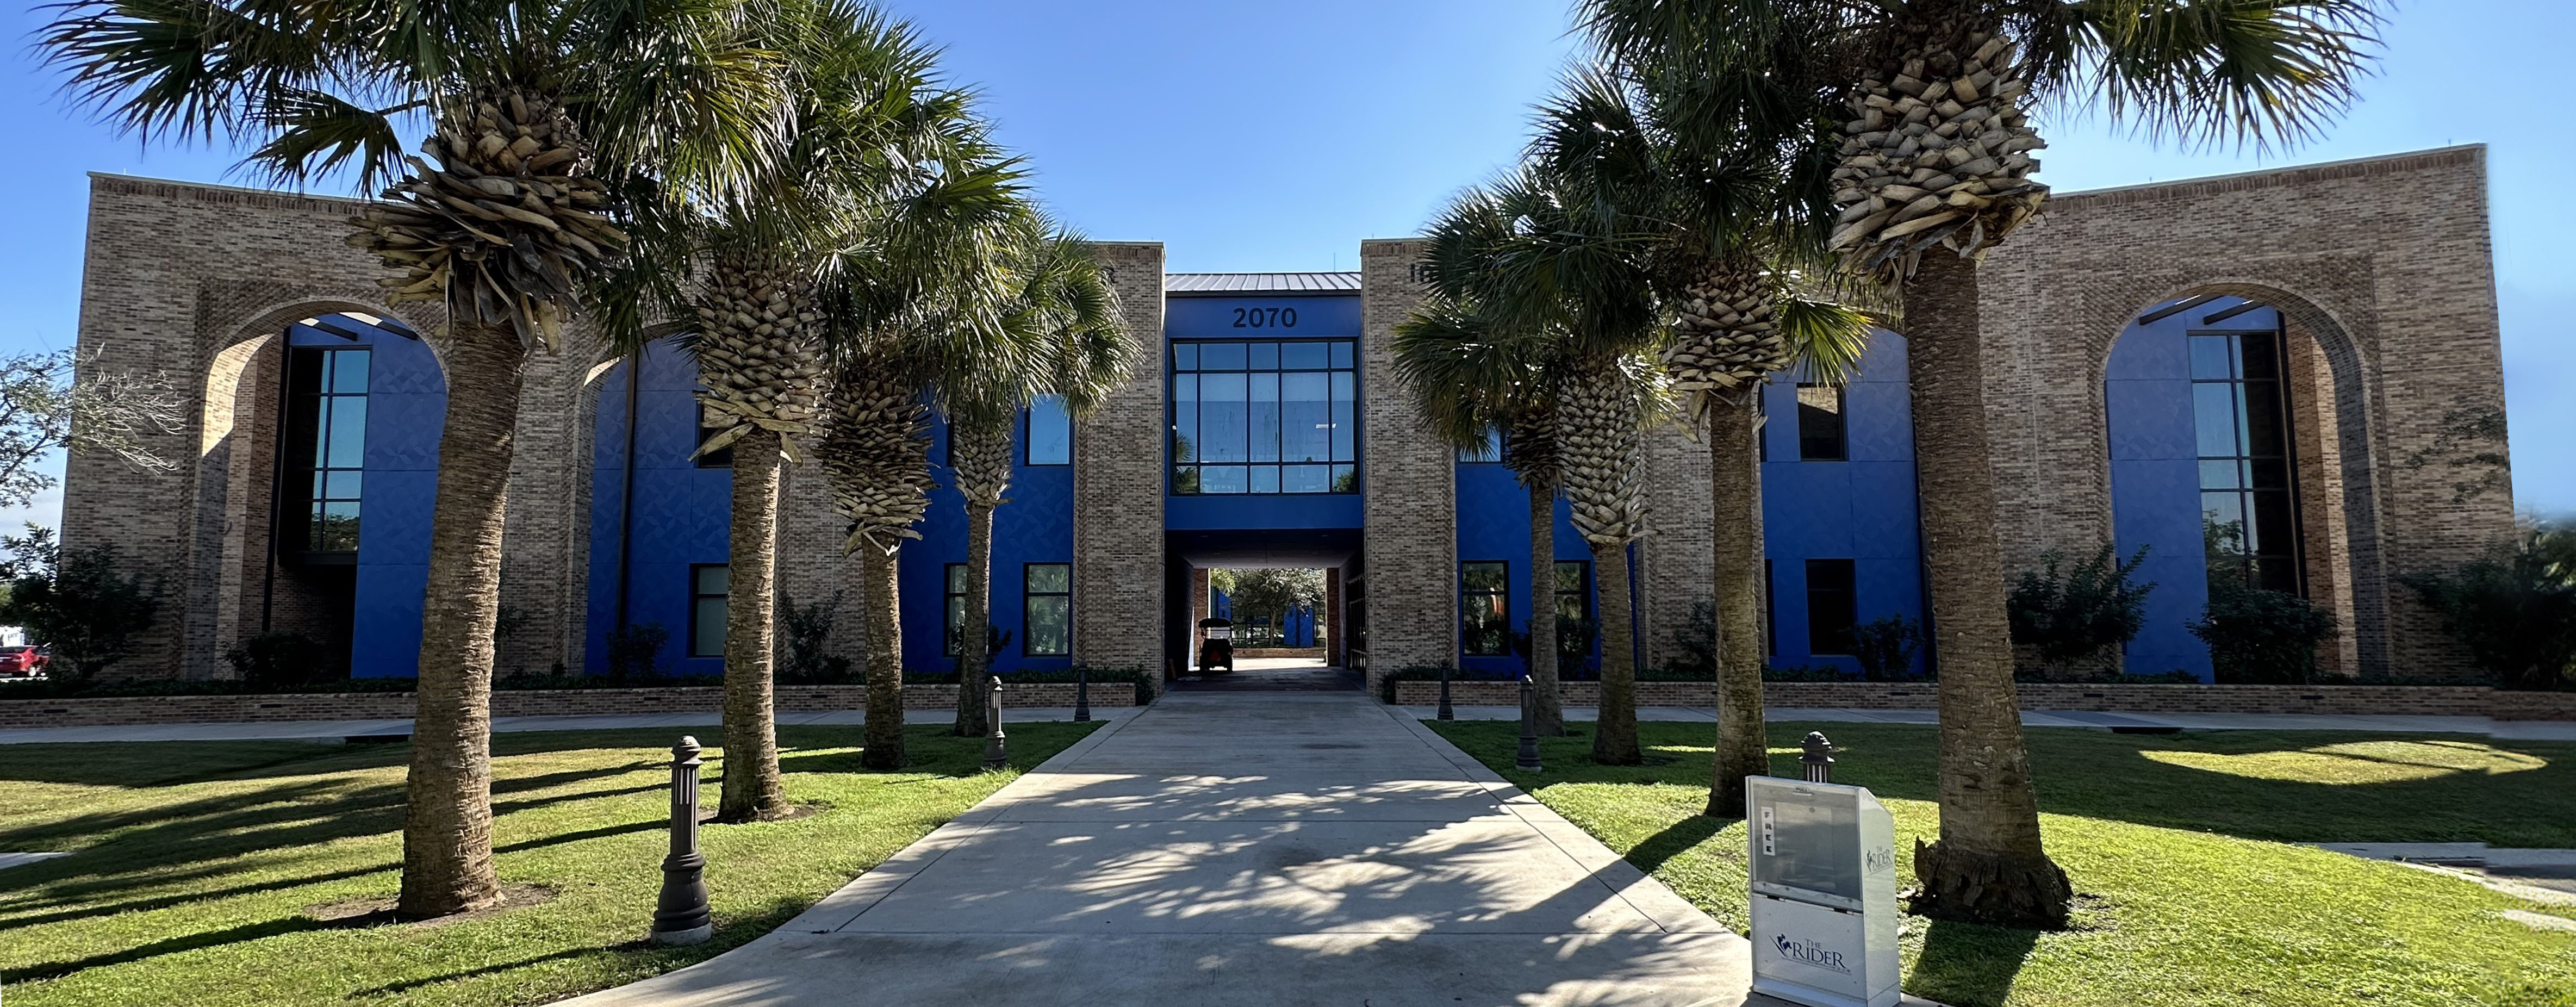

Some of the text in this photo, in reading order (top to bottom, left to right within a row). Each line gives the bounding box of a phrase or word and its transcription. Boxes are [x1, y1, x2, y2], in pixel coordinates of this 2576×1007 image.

[1233, 307, 1297, 328] 2070
[1872, 849, 1891, 868] RIDER
[1805, 938, 1822, 949] THE
[1792, 942, 1847, 969] RIDER
